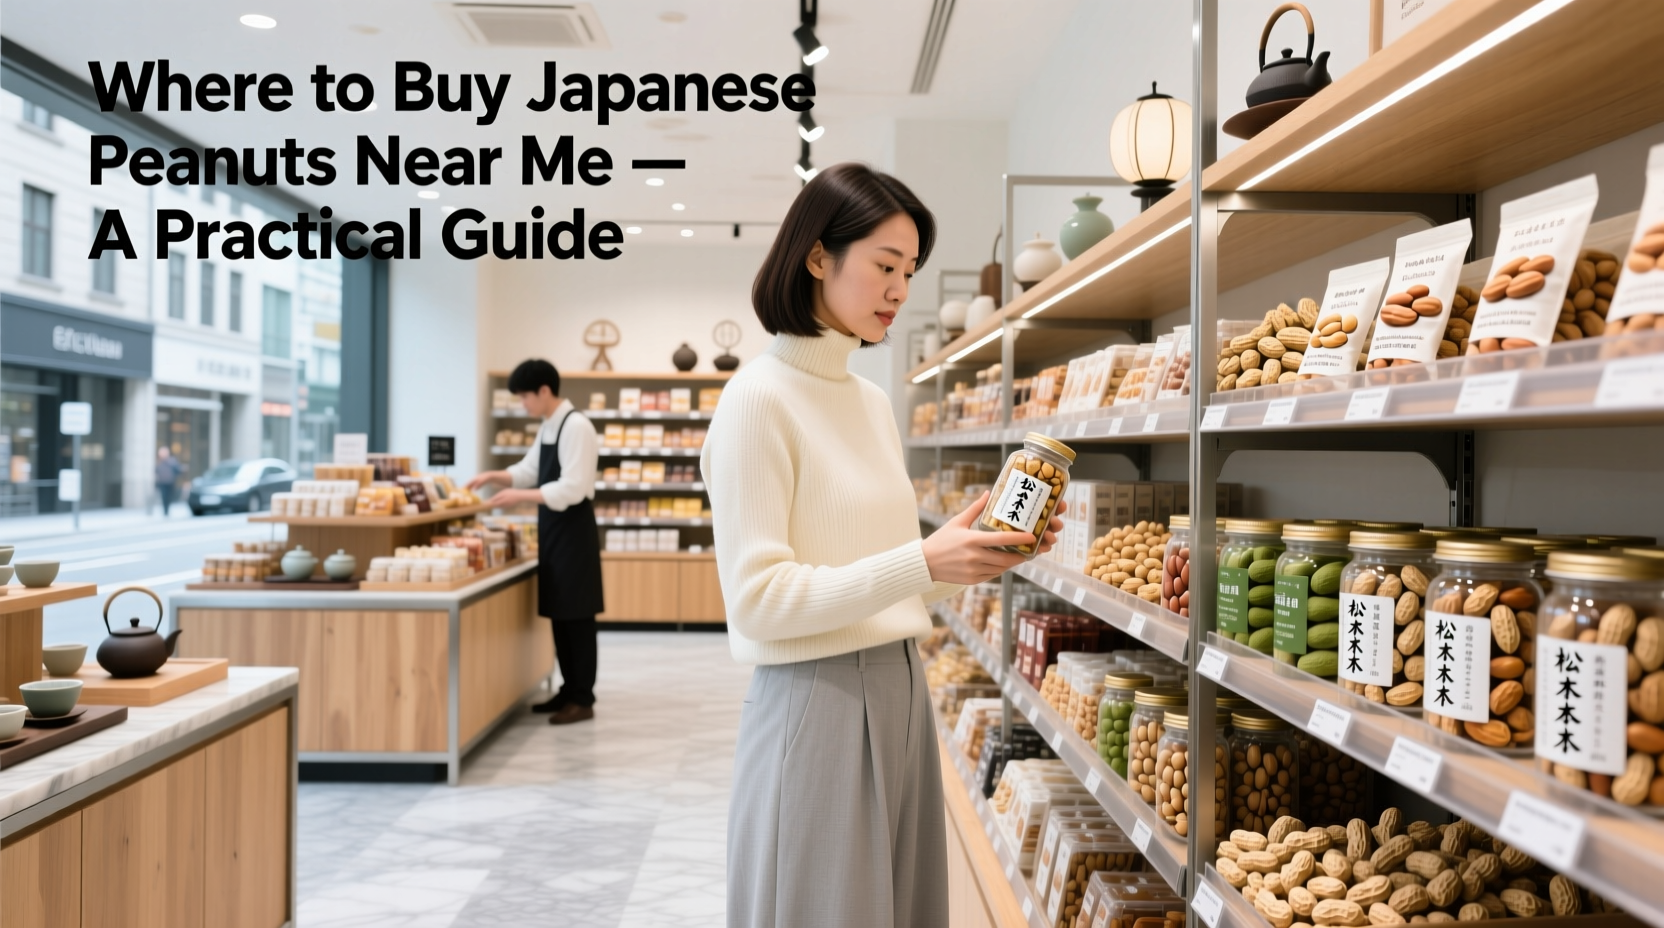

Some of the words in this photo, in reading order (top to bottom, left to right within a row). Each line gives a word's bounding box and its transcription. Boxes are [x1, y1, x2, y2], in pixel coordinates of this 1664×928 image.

[1346, 599, 1367, 673] 松木木木
[1433, 619, 1457, 707] 松木木木
[1554, 647, 1584, 753] 松木木木
